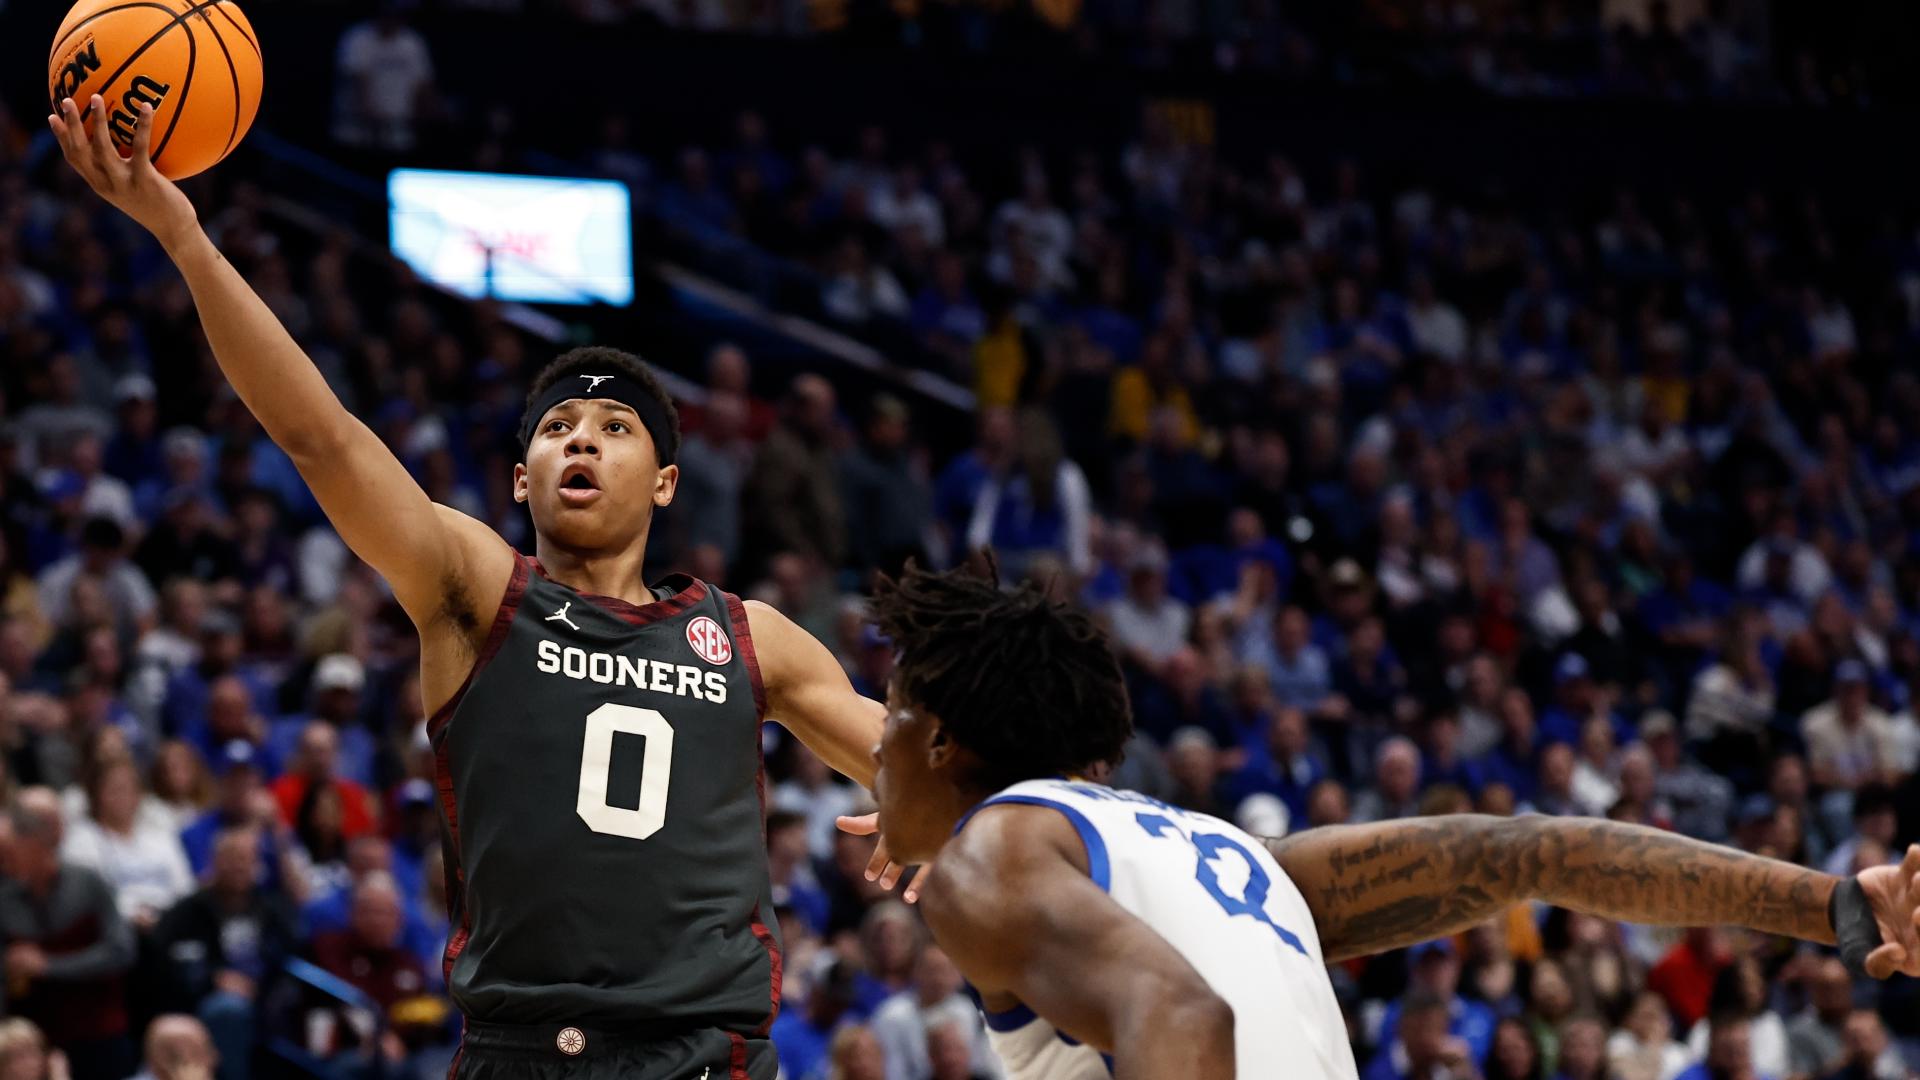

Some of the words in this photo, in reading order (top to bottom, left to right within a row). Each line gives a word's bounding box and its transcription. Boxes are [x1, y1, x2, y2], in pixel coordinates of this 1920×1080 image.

[537, 639, 727, 704] SOONERS
[688, 618, 731, 663] SEC
[576, 702, 675, 840] 0
